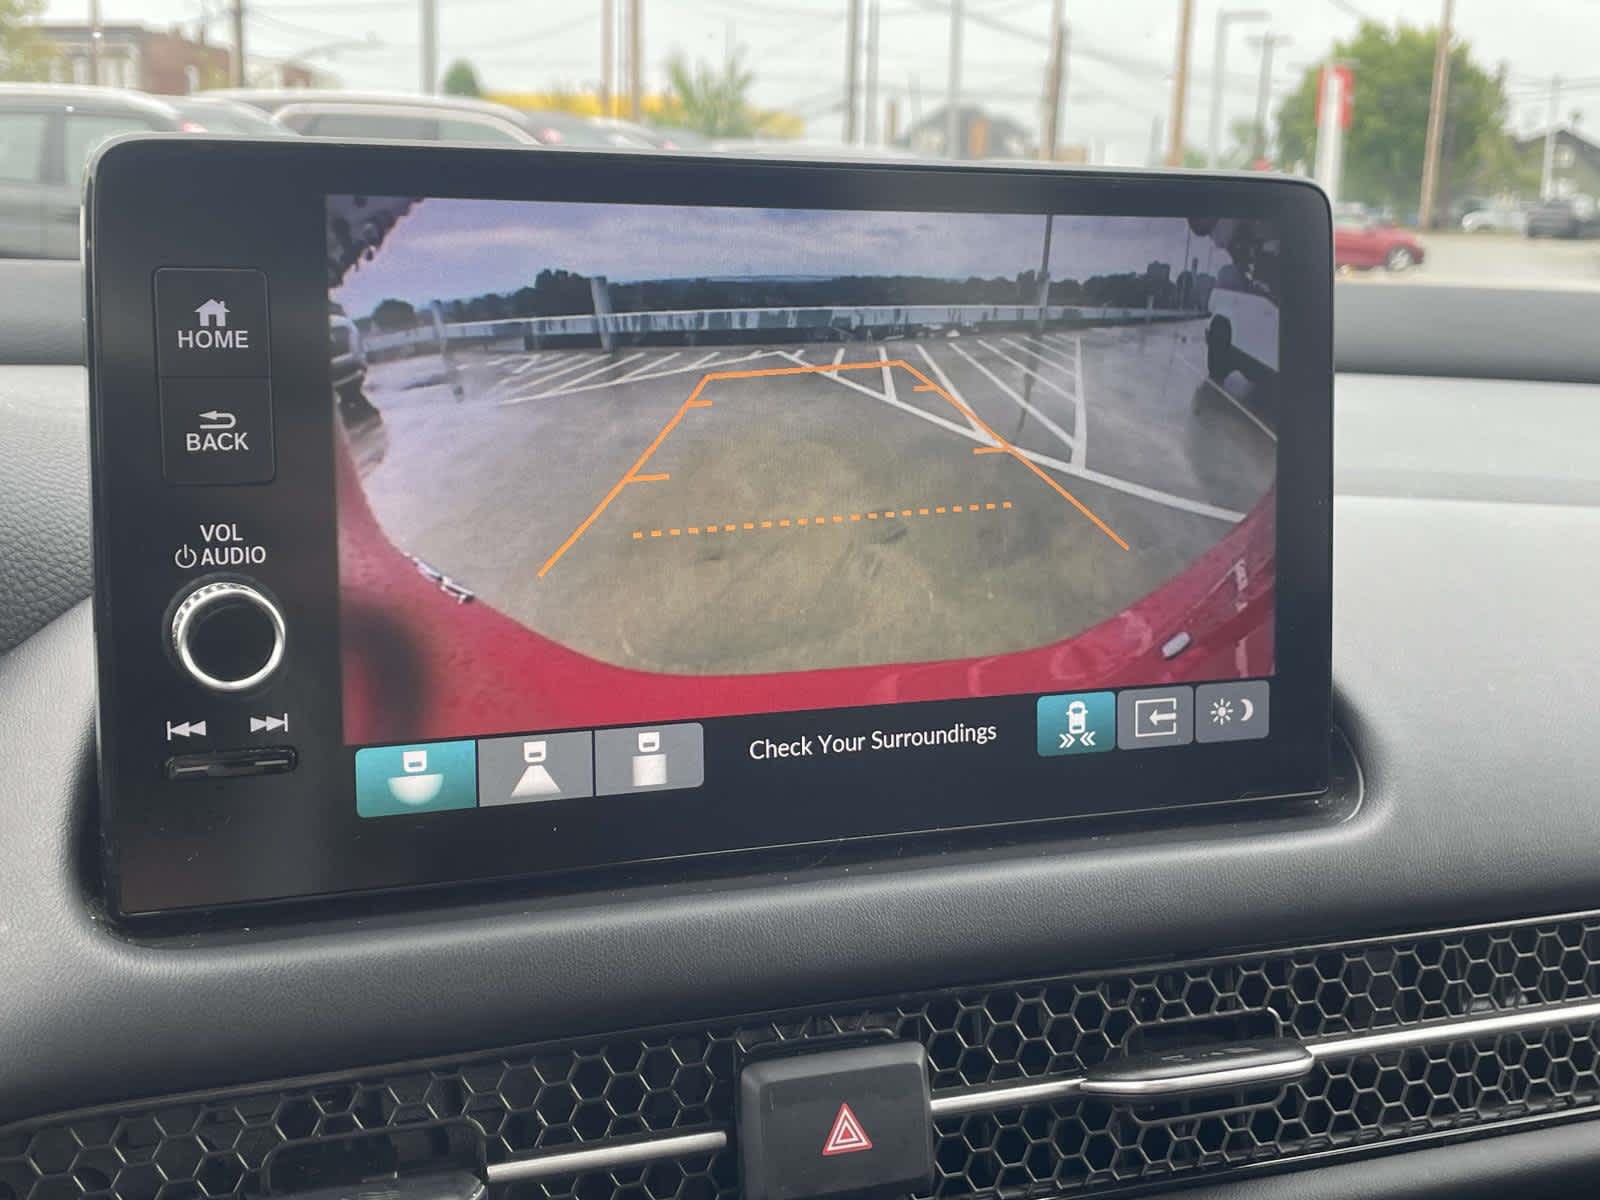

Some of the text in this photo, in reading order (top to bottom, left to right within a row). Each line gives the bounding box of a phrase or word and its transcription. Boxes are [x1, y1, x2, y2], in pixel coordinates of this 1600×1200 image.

[177, 329, 249, 349] HOME
[186, 431, 249, 452] BACK
[199, 523, 244, 543] VOL
[200, 545, 267, 566] AUDIO
[749, 722, 997, 760] Check Your Surroundings
